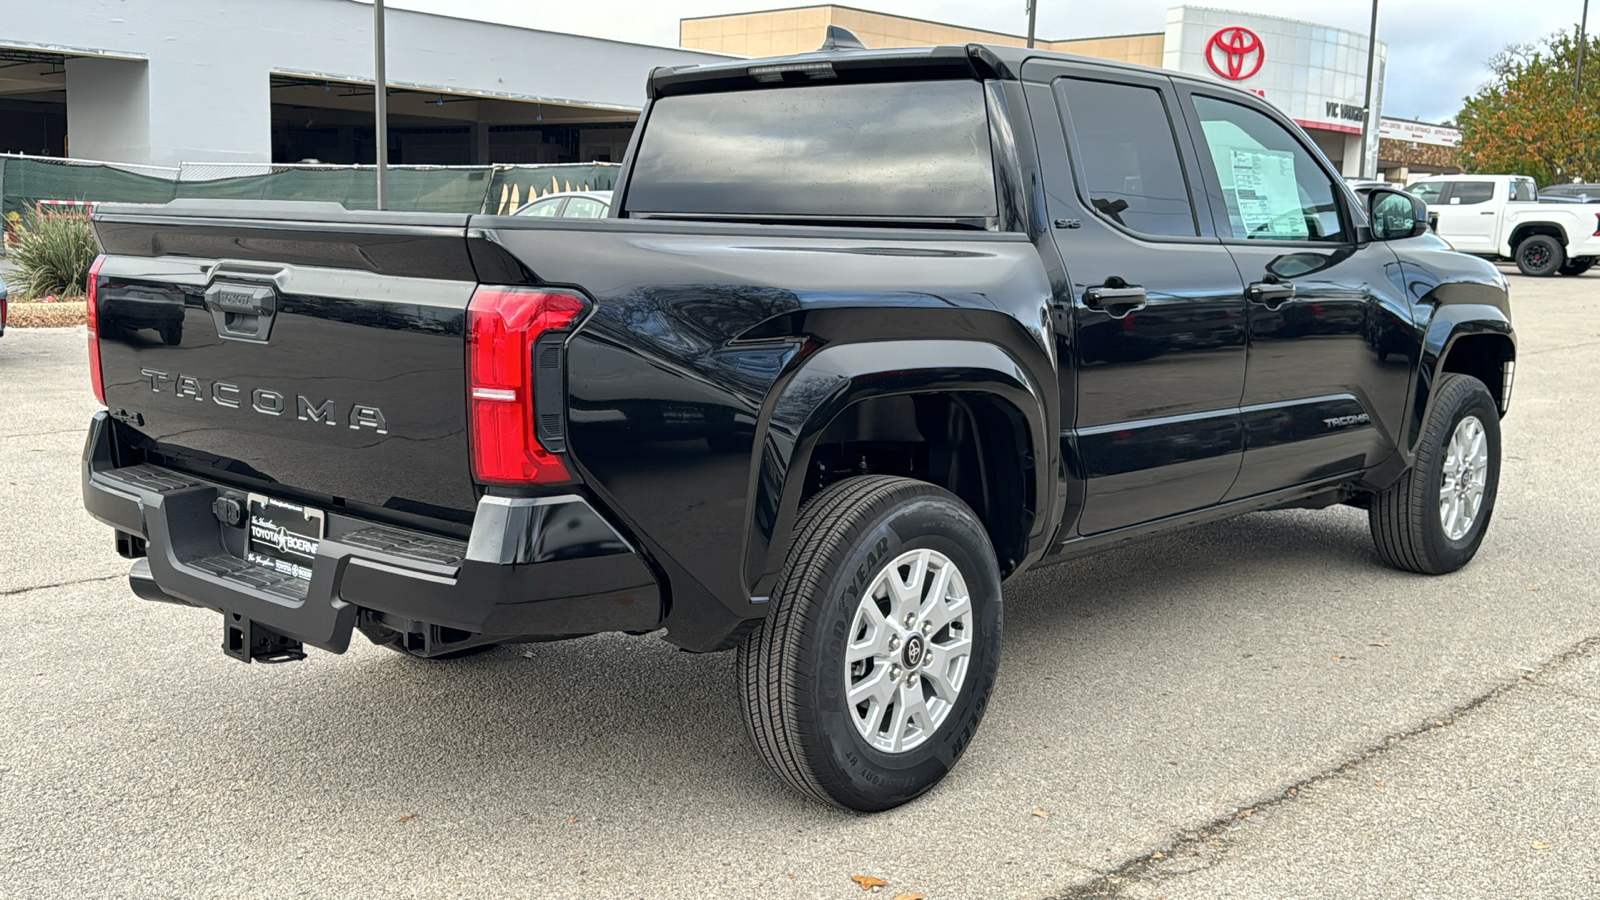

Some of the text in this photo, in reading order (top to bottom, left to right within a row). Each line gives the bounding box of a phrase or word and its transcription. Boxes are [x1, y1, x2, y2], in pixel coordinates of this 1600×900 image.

[1326, 101, 1339, 118] VIC
[220, 292, 252, 306] TOYOTA
[140, 367, 388, 434] TACOMA
[1322, 413, 1370, 428] TACOMA
[251, 526, 318, 554] TOYOTA BOERNE
